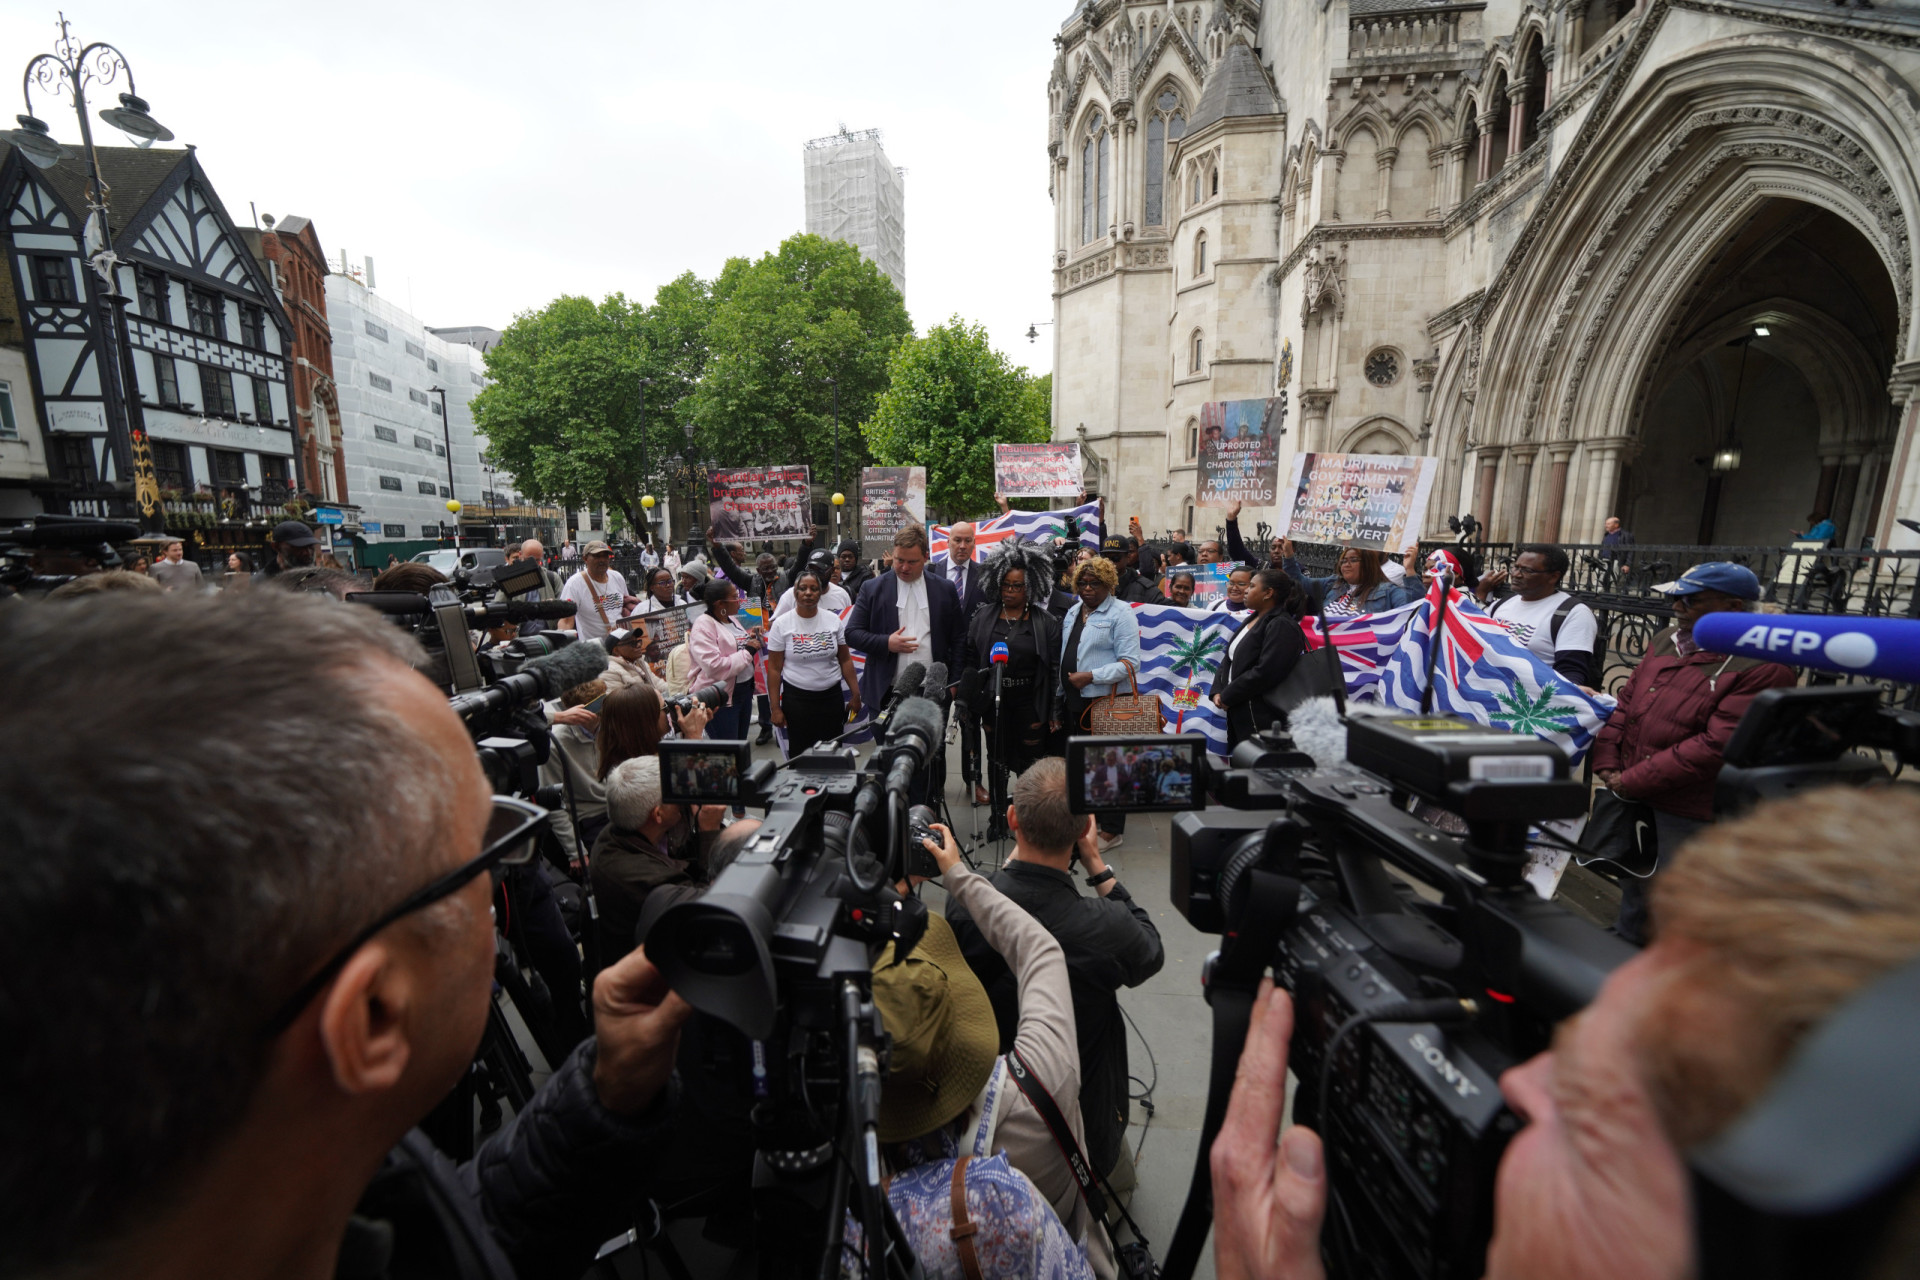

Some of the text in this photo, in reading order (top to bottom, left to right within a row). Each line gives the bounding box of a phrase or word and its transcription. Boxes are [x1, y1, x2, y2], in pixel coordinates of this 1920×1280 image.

[206, 426, 248, 441] GEORGE
[998, 445, 1069, 453] Mauritian Govt
[1216, 441, 1260, 450] UPROOTED
[1003, 465, 1067, 474] Chagossians
[1206, 460, 1260, 468] CHAGOSSIAN
[1320, 458, 1400, 471] MAURITIAN
[712, 470, 804, 483] Mauritian Police
[1044, 478, 1073, 488] rights
[1309, 471, 1407, 485] GOVERNMENT
[1207, 478, 1265, 489] POVERTY
[713, 485, 806, 498] brutality against
[1202, 489, 1272, 501] MAURITIUS
[1316, 484, 1392, 499] STOLE OUR
[724, 500, 797, 513] Chagossians
[1298, 497, 1409, 514] COMPENSATION
[1294, 510, 1405, 529] MADE US LIVE IN
[1200, 591, 1224, 601] Illois
[1735, 625, 1822, 655] AFP
[1408, 1033, 1481, 1098] SONY
[1076, 1166, 1090, 1186] EOS
